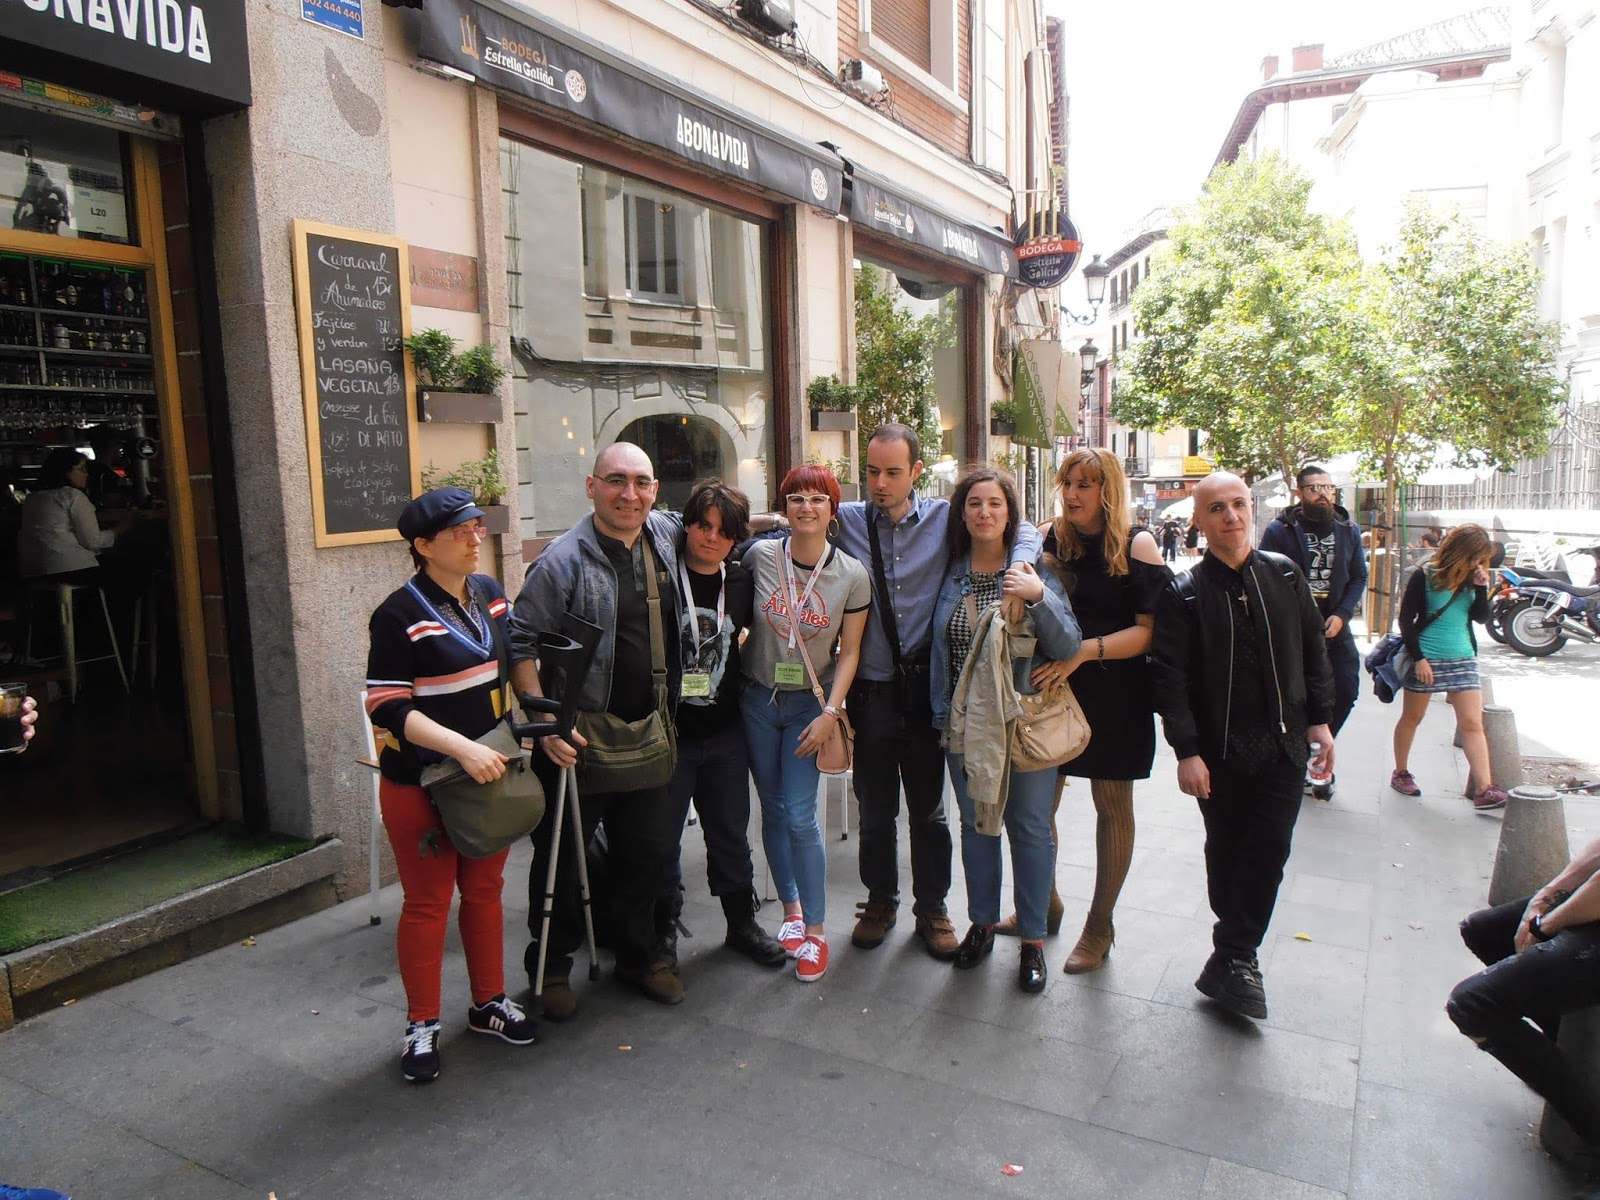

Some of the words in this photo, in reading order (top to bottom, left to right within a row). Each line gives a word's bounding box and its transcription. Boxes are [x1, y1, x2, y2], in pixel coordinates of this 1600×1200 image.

[324, 1, 342, 15] 444
[343, 9, 361, 22] 440
[5, 0, 212, 64] AVIDA
[501, 37, 548, 66] BODEGA
[484, 46, 522, 74] Estrella
[522, 62, 554, 87] Galicia
[676, 113, 750, 170] ABONAVIDA
[90, 206, 107, 218] L20
[318, 244, 390, 274] Carnaval
[1019, 243, 1063, 258] BODEGA
[344, 273, 358, 292] de
[1028, 265, 1059, 280] Galicia
[321, 280, 387, 312] Ahumados
[312, 311, 357, 335] Fajitas
[317, 337, 327, 351] y
[320, 356, 393, 374] LASAÑA
[319, 376, 384, 395] VEGETAL
[1018, 357, 1047, 441] PELUQUEROS
[761, 596, 830, 628] Aneles
